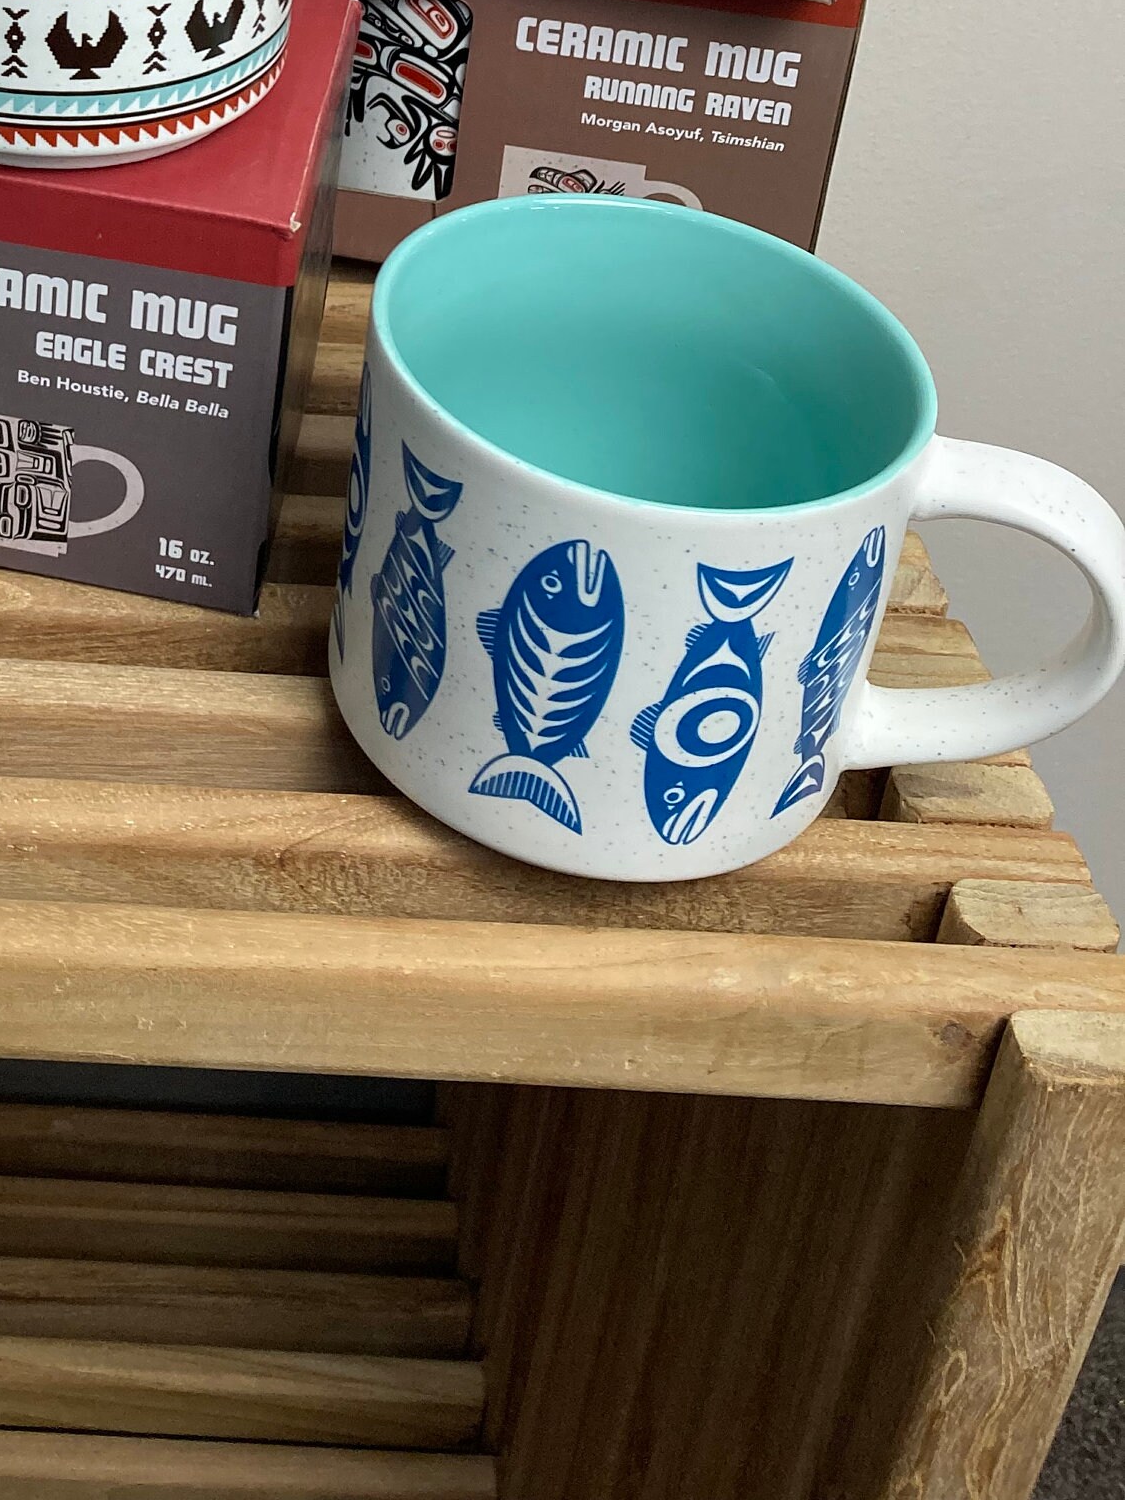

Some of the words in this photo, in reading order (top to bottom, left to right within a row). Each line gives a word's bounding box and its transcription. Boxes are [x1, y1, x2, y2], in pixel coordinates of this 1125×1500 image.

[516, 17, 688, 72] CERAMIC
[704, 41, 802, 87] MUG
[583, 75, 696, 113] RUNNING
[705, 92, 792, 126] RAVEN
[581, 113, 641, 133] Morgan
[645, 121, 705, 142] Asoyuf,
[711, 131, 785, 152] Tsimshian
[130, 289, 239, 346] MUG
[35, 331, 127, 370] EAGLE
[139, 349, 233, 389] CREST
[18, 370, 50, 387] Ben
[56, 376, 129, 403] Houstie,
[136, 390, 180, 410] Bella
[185, 399, 229, 419] Bella
[155, 564, 186, 582] 470
[159, 537, 183, 559] 16
